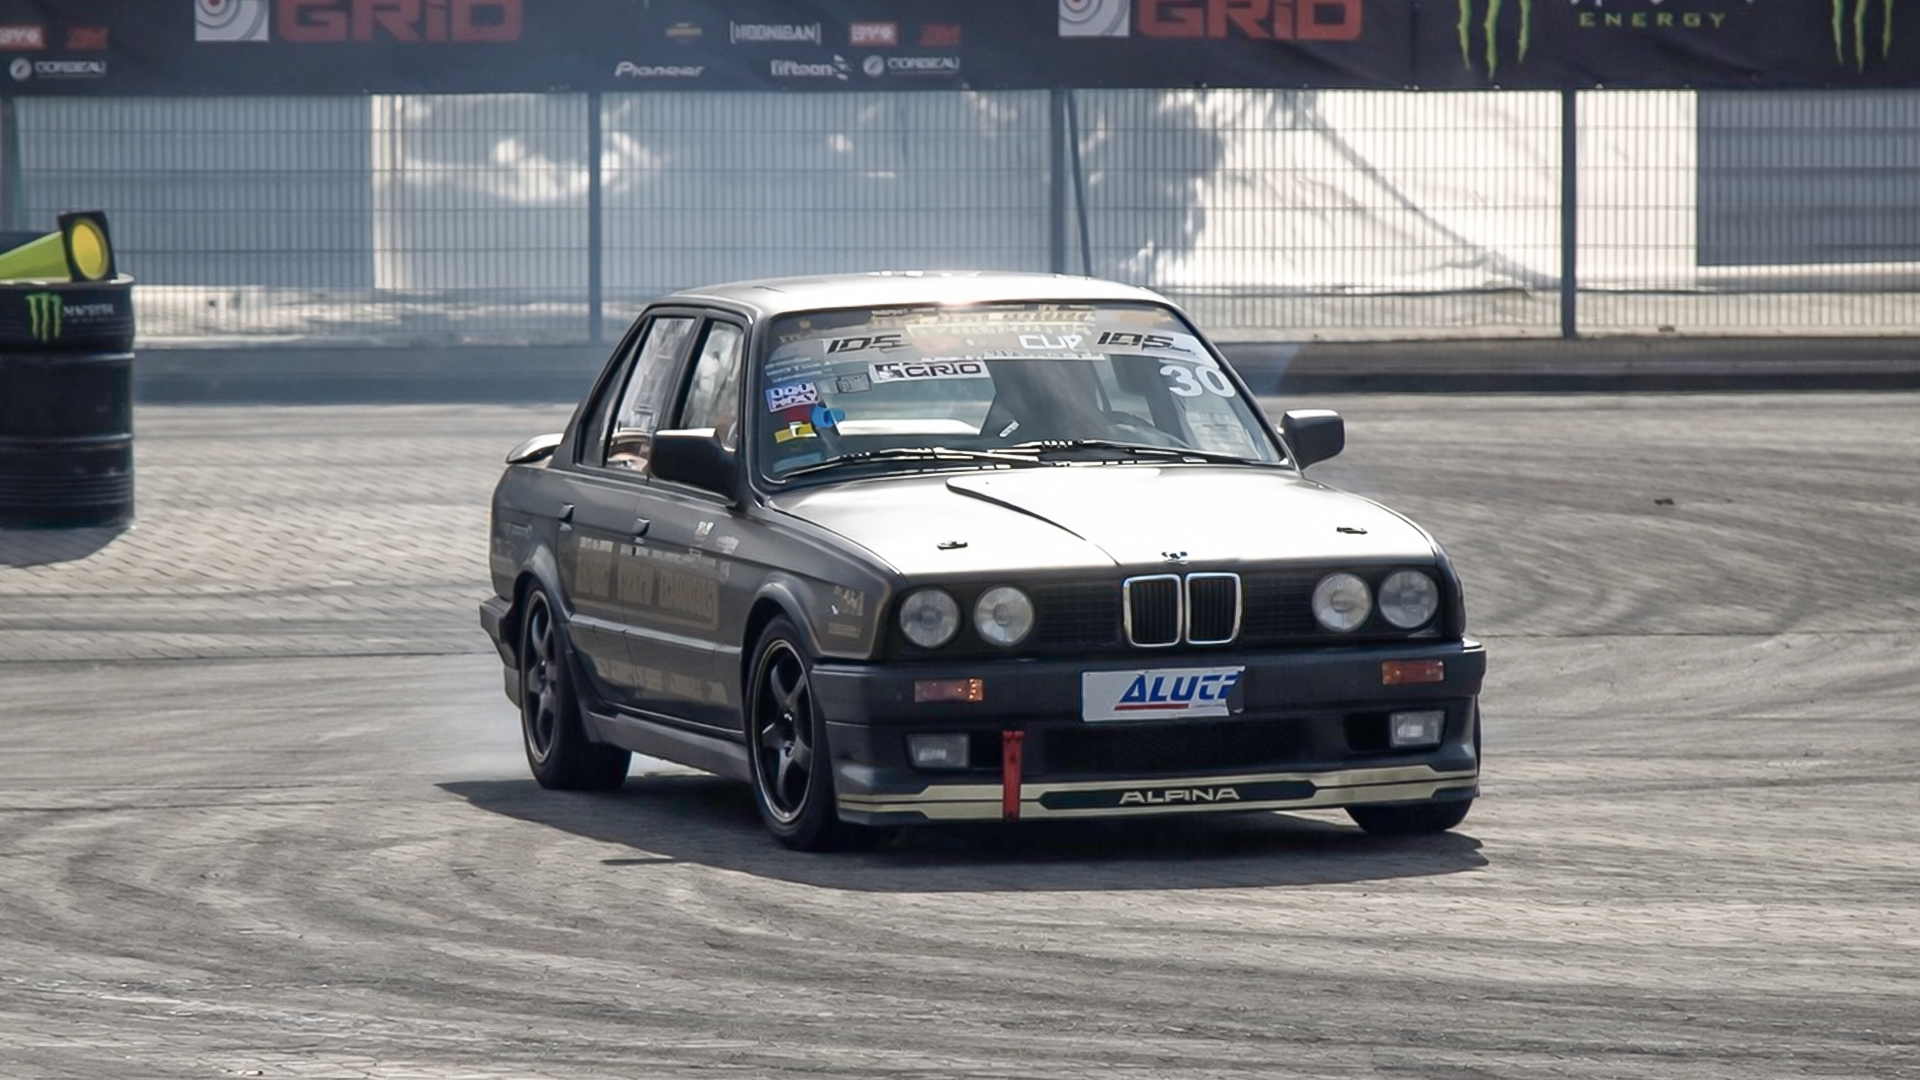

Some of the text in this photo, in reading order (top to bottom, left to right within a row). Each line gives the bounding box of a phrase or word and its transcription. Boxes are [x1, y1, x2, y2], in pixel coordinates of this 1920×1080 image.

[1579, 11, 1726, 29] ENERGY
[614, 61, 705, 78] Pioneer
[1159, 365, 1236, 398] 30
[1118, 787, 1241, 805] ALPINA
